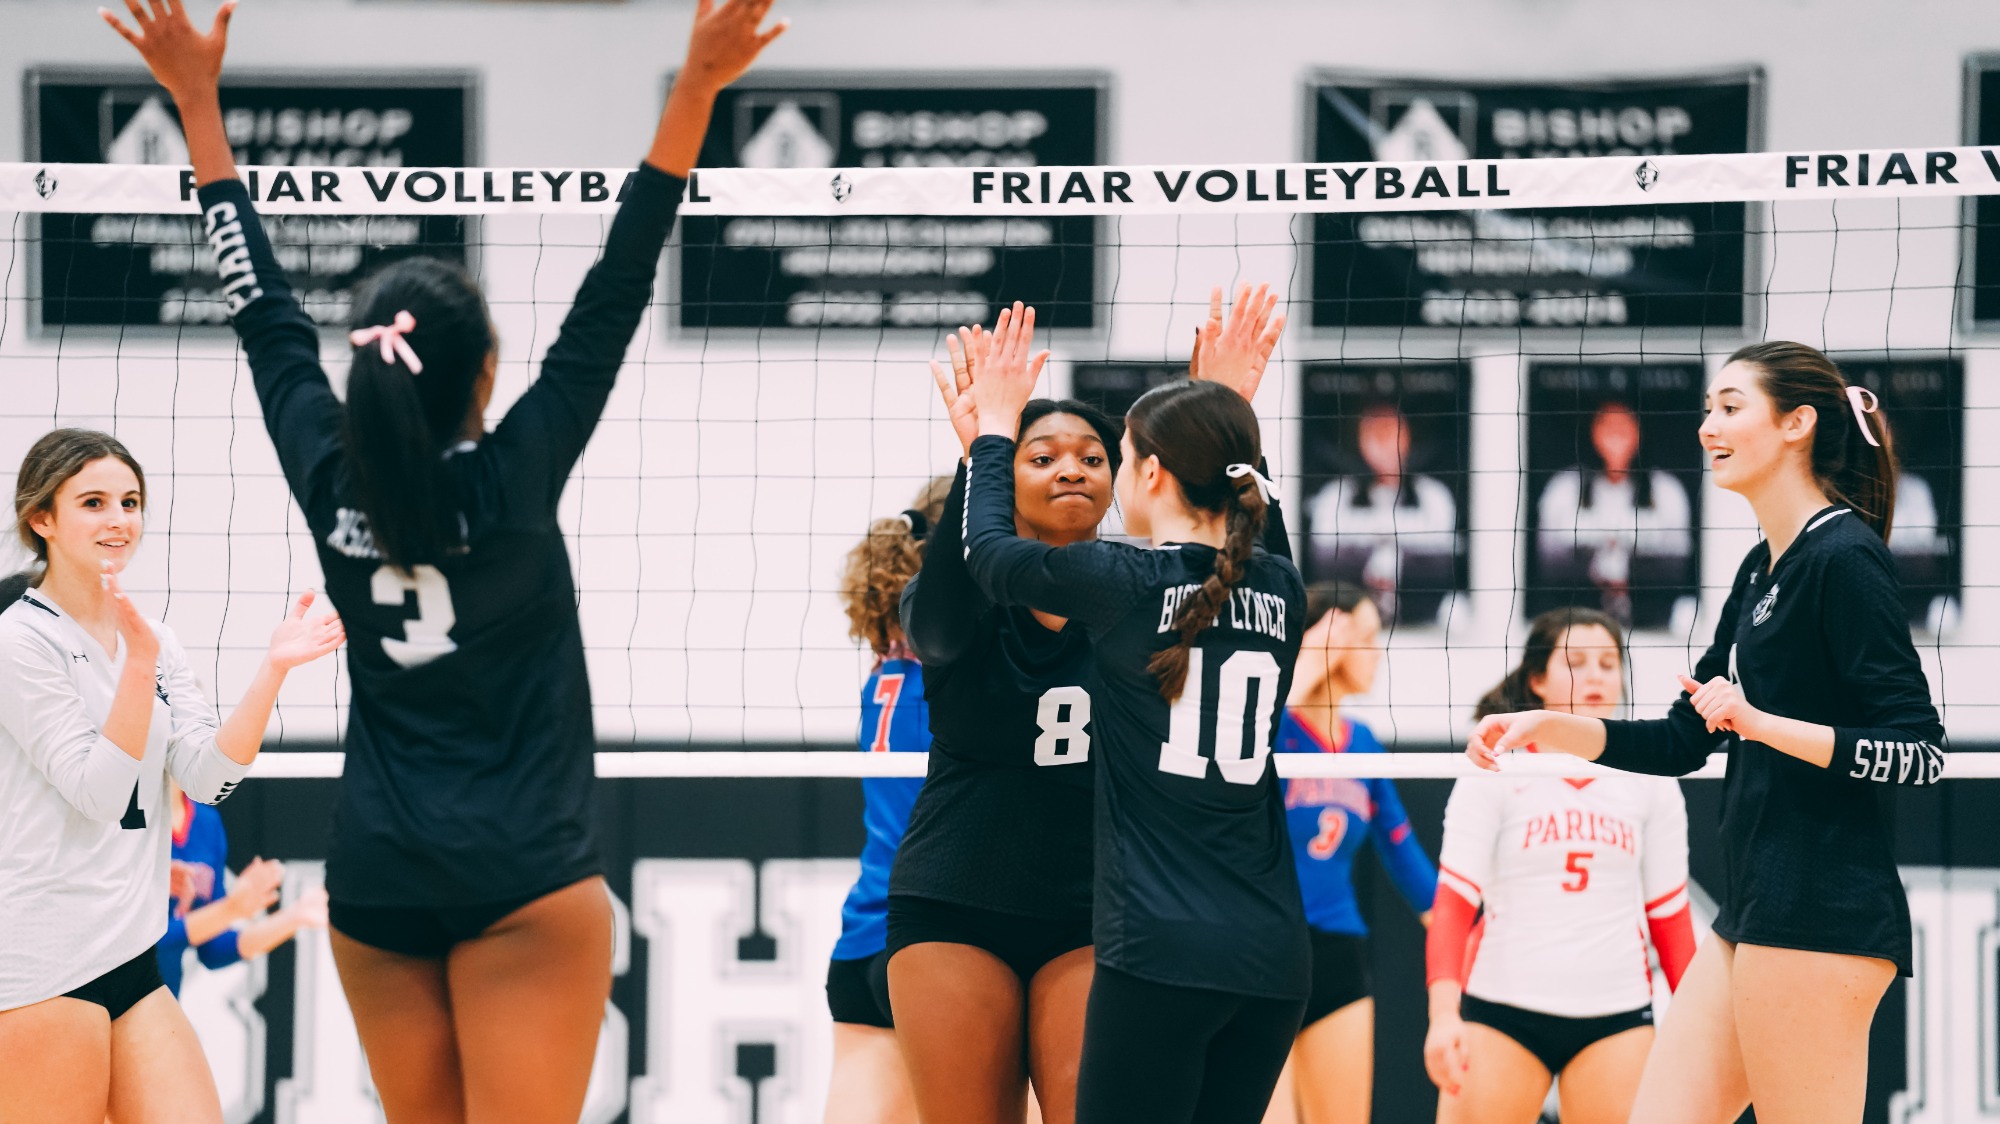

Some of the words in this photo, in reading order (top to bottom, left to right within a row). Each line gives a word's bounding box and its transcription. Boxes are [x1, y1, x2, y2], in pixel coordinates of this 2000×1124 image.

[1492, 107, 1692, 147] BISHOP
[180, 170, 342, 202] FIAR
[362, 170, 711, 203] VOLLEYBL
[973, 171, 1134, 204] FRIAR
[1154, 164, 1510, 203] VOLLEYBALL
[1786, 151, 1960, 188] FRIAR
[370, 564, 458, 669] 3
[1229, 587, 1286, 642] LYNCH
[872, 673, 905, 752] 7
[1034, 686, 1091, 766] 8
[1158, 648, 1281, 786] 10
[1523, 809, 1635, 856] PARISH
[1562, 851, 1593, 892] 5
